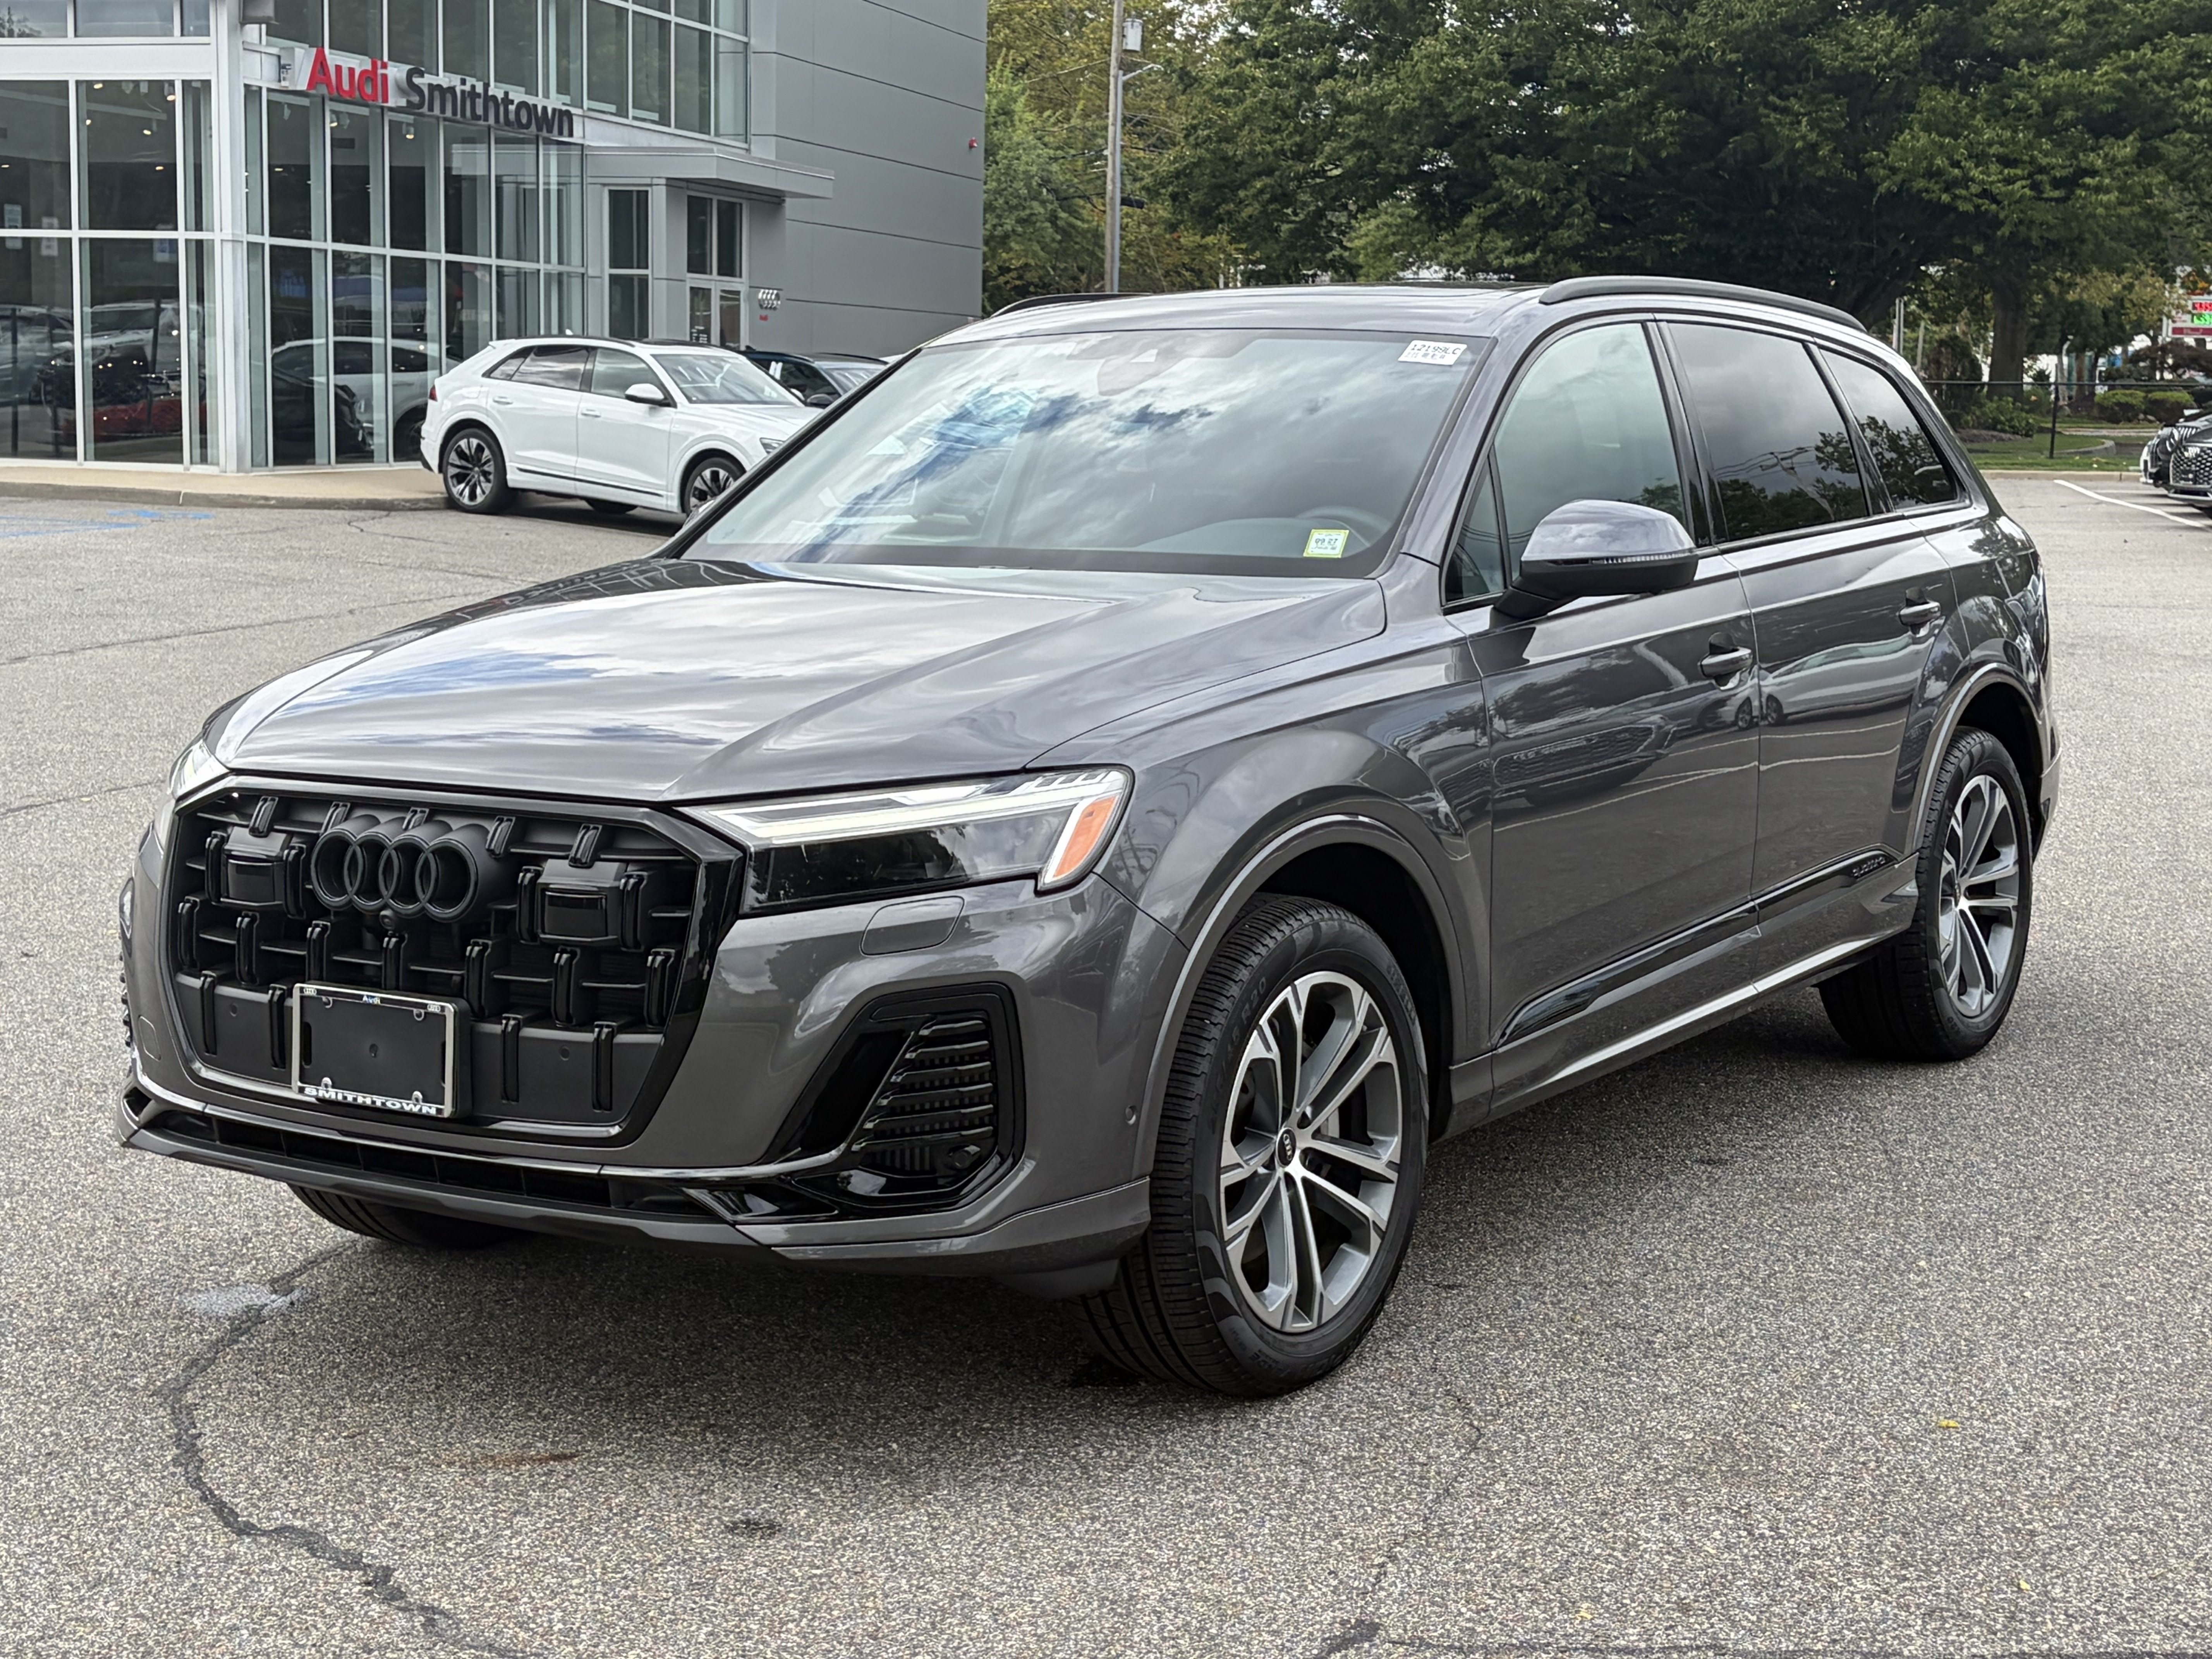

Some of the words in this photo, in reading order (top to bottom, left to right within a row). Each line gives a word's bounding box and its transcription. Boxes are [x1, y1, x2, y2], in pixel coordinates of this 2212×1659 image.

[307, 48, 388, 103] Audi
[406, 67, 574, 137] Smithtown
[304, 1087, 436, 1115] SMITHTOWN
